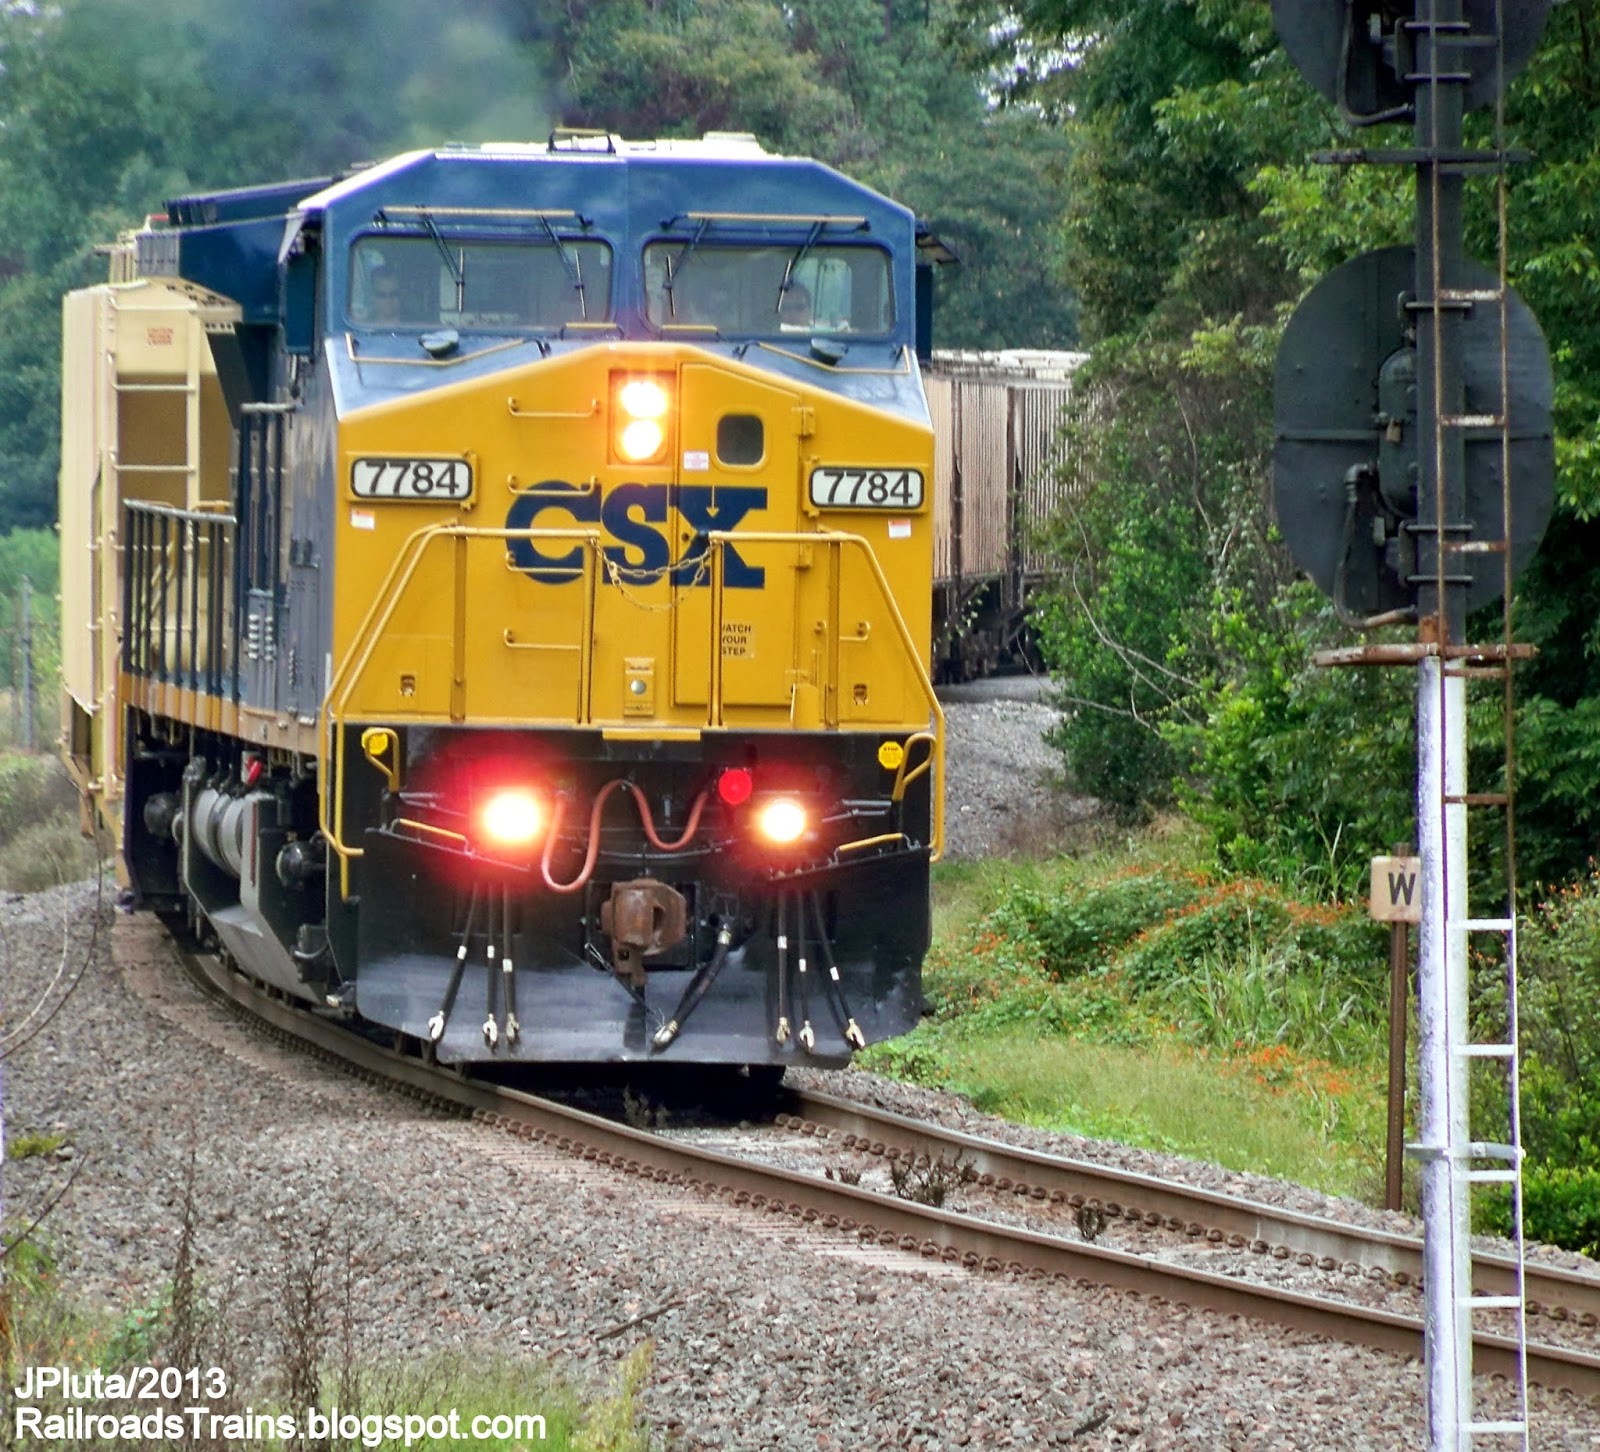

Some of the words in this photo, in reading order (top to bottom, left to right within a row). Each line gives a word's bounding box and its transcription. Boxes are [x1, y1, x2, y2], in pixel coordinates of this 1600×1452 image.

[365, 460, 460, 496] 7784
[823, 469, 913, 505] 7784
[505, 479, 768, 590] CSX
[1388, 872, 1416, 906] W
